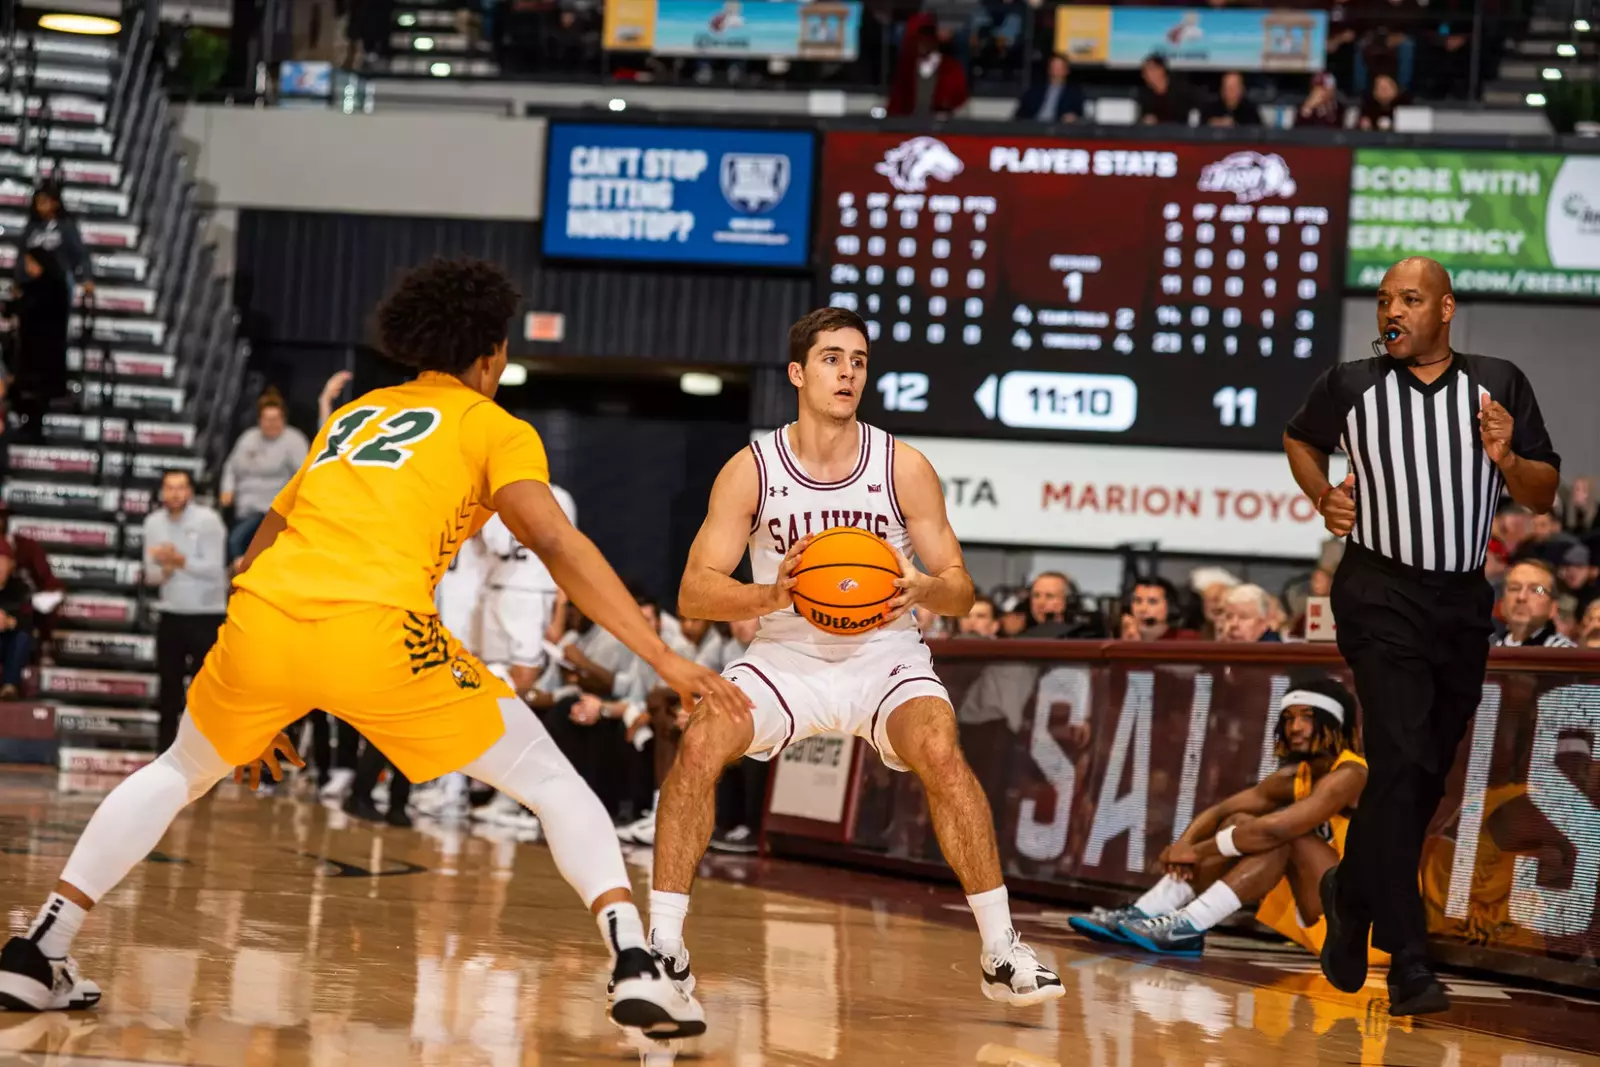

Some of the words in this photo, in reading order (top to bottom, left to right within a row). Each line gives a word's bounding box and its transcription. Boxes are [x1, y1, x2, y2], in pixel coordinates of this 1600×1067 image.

[570, 147, 641, 176] CAN'T
[643, 149, 708, 180] STOP
[989, 146, 1090, 174] PLAYER
[1092, 150, 1178, 178] STATS
[568, 178, 673, 209] BETTING
[1352, 165, 1453, 192] SCORE
[1458, 169, 1542, 196] WITH
[566, 209, 695, 242] NONSTOP?
[1350, 196, 1473, 224] ENERGY
[1348, 225, 1527, 255] EFFICIENCY
[1063, 271, 1083, 302] 1
[1115, 308, 1135, 330] 2
[876, 371, 930, 412] 12
[1028, 387, 1112, 416] 11:10
[1212, 386, 1257, 427] 11
[307, 405, 442, 470] 12
[1041, 480, 1199, 518] MARION
[811, 607, 884, 630] Wilson
